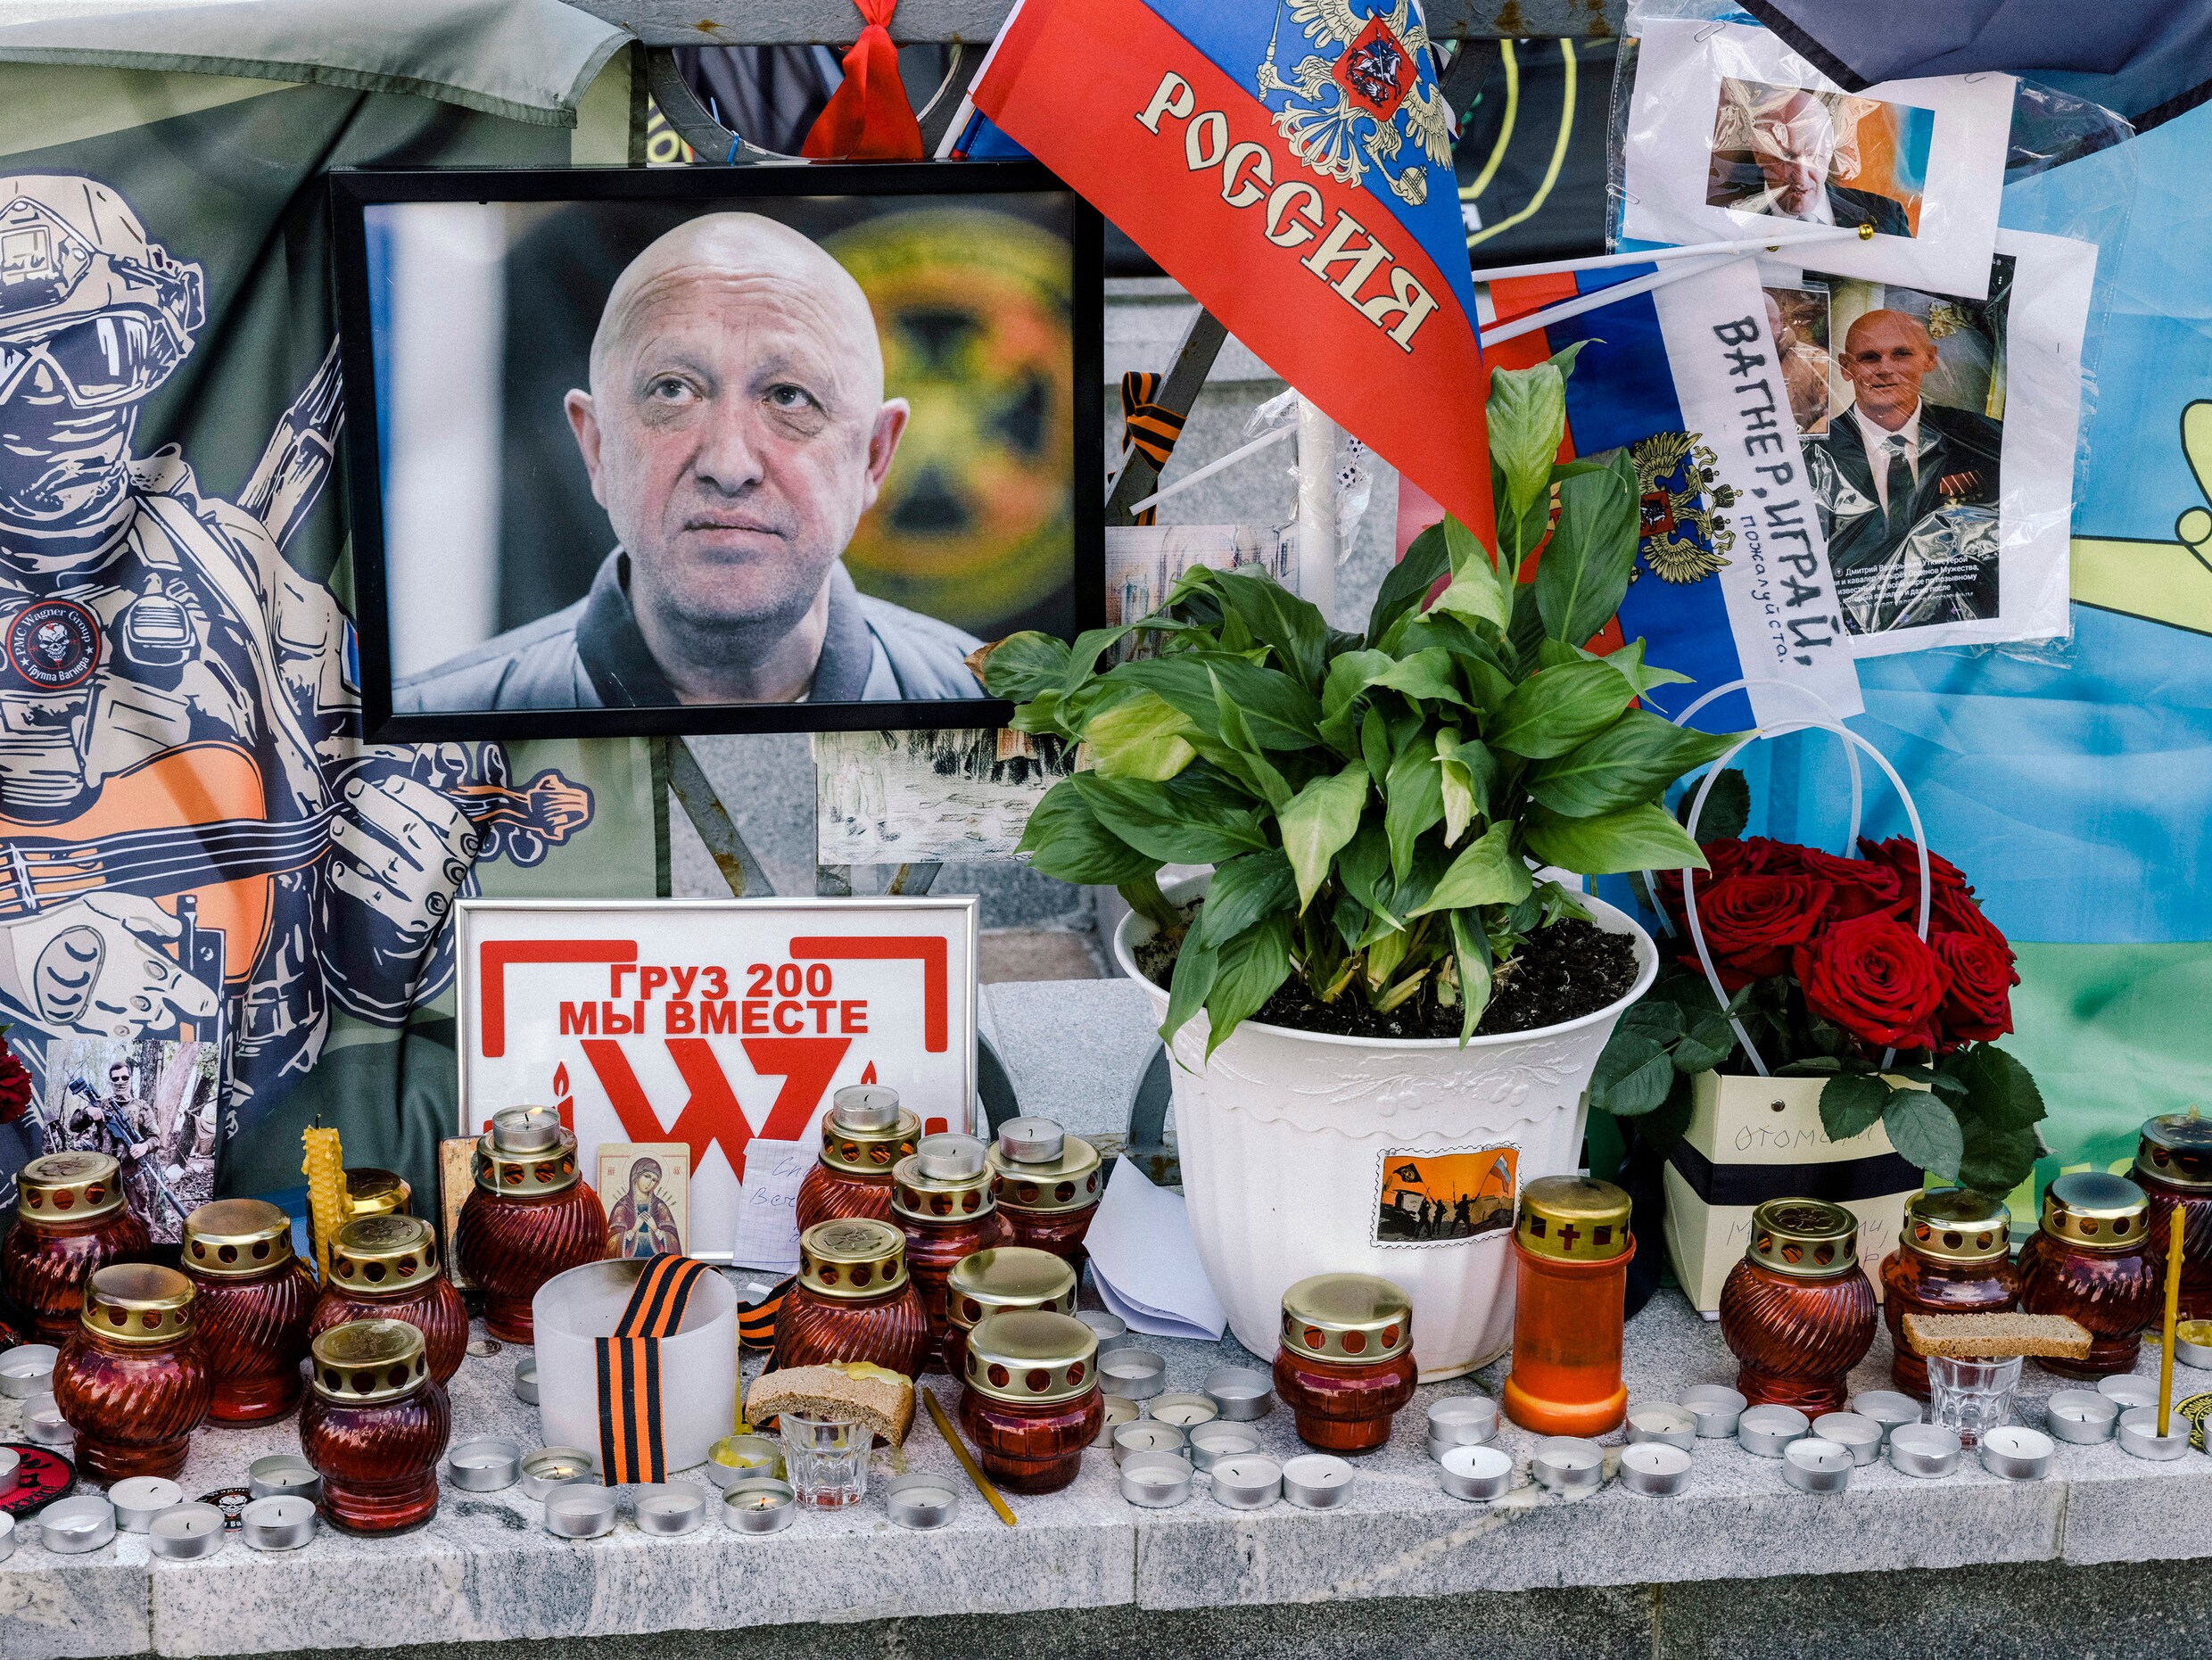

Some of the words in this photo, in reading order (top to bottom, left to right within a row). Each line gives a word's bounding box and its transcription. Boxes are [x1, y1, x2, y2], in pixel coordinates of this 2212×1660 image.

[1134, 70, 1440, 354] РОССИЯ
[1845, 565, 1878, 577] Дмитрий
[14, 628, 27, 656] PMC
[21, 608, 67, 627] Wagner
[68, 610, 91, 642] Group
[28, 665, 57, 681] Группа
[58, 657, 90, 681] Вагнера
[610, 963, 729, 1000] ГРУЗ
[746, 962, 832, 998] 200
[559, 1000, 645, 1036] МЫ
[665, 1000, 869, 1035] ВМЕСТЕ
